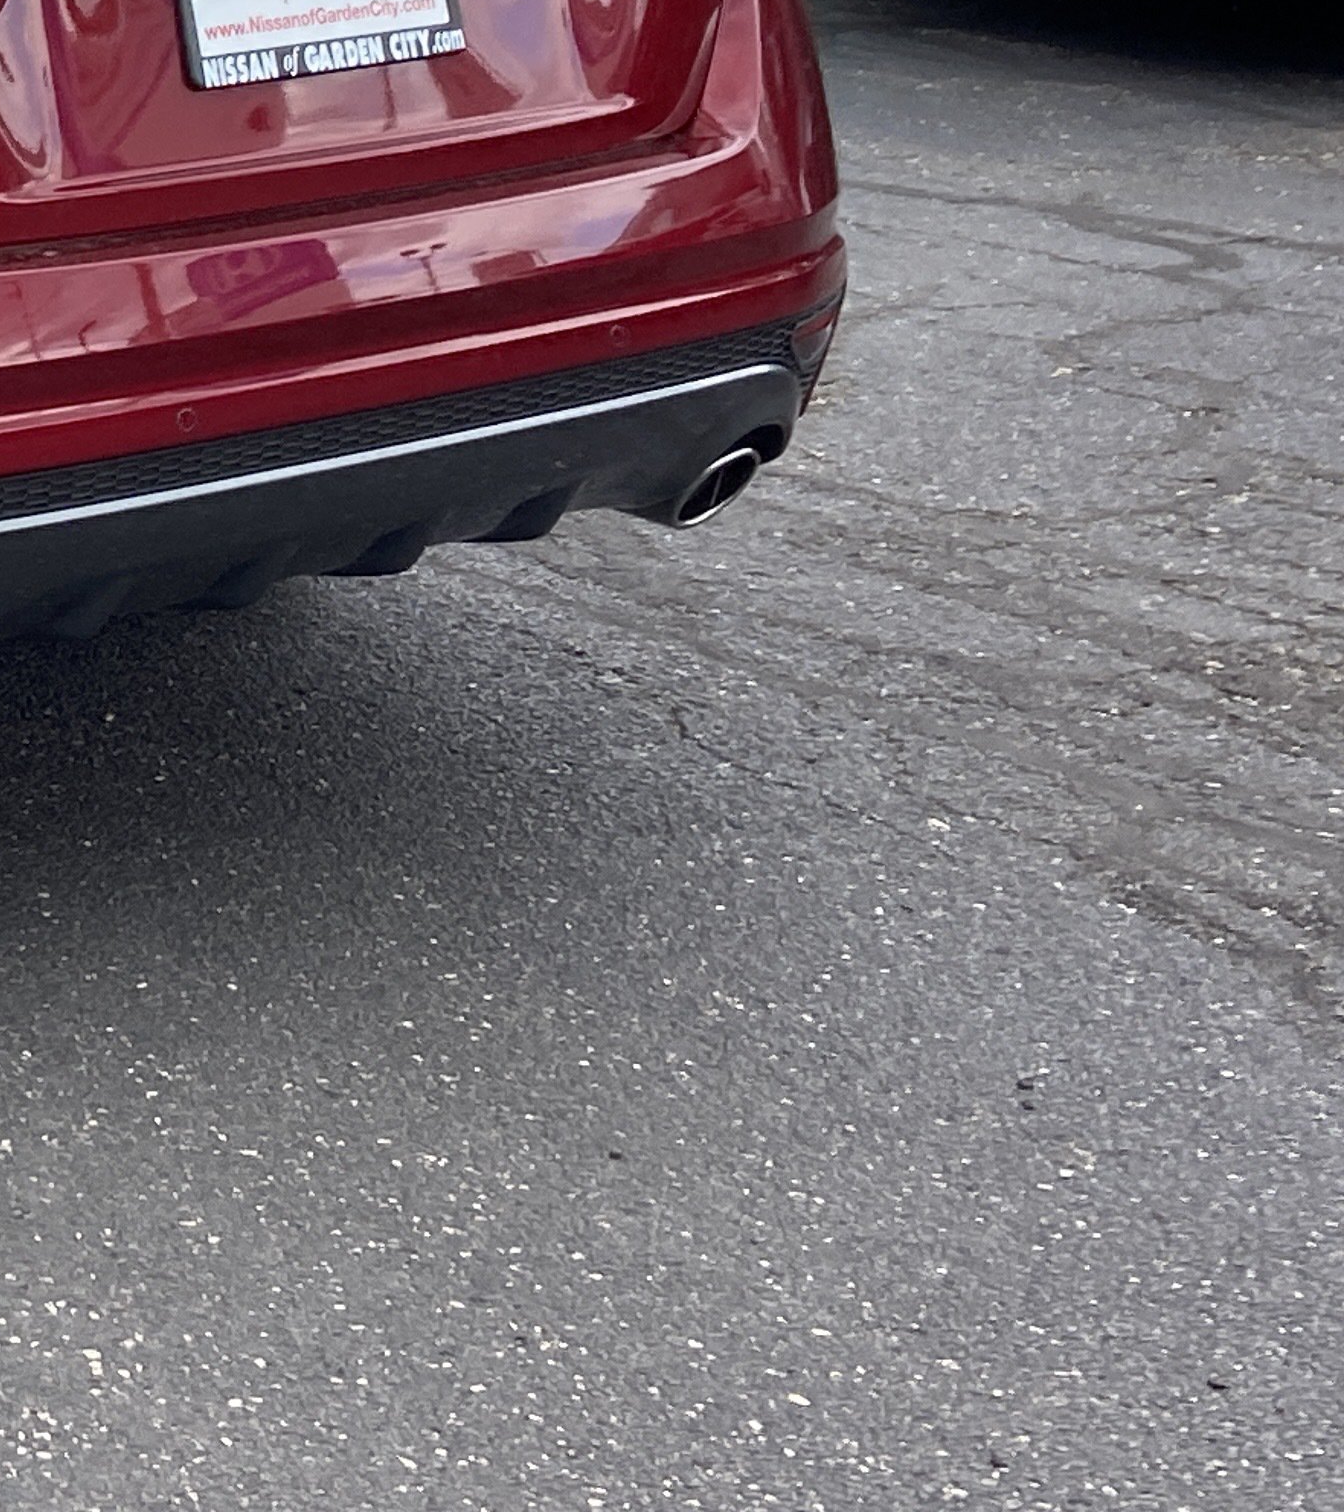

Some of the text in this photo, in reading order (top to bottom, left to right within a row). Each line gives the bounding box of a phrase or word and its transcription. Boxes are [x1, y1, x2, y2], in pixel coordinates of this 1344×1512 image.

[202, 28, 466, 89] NISSAN of GARDEN CITY.com
